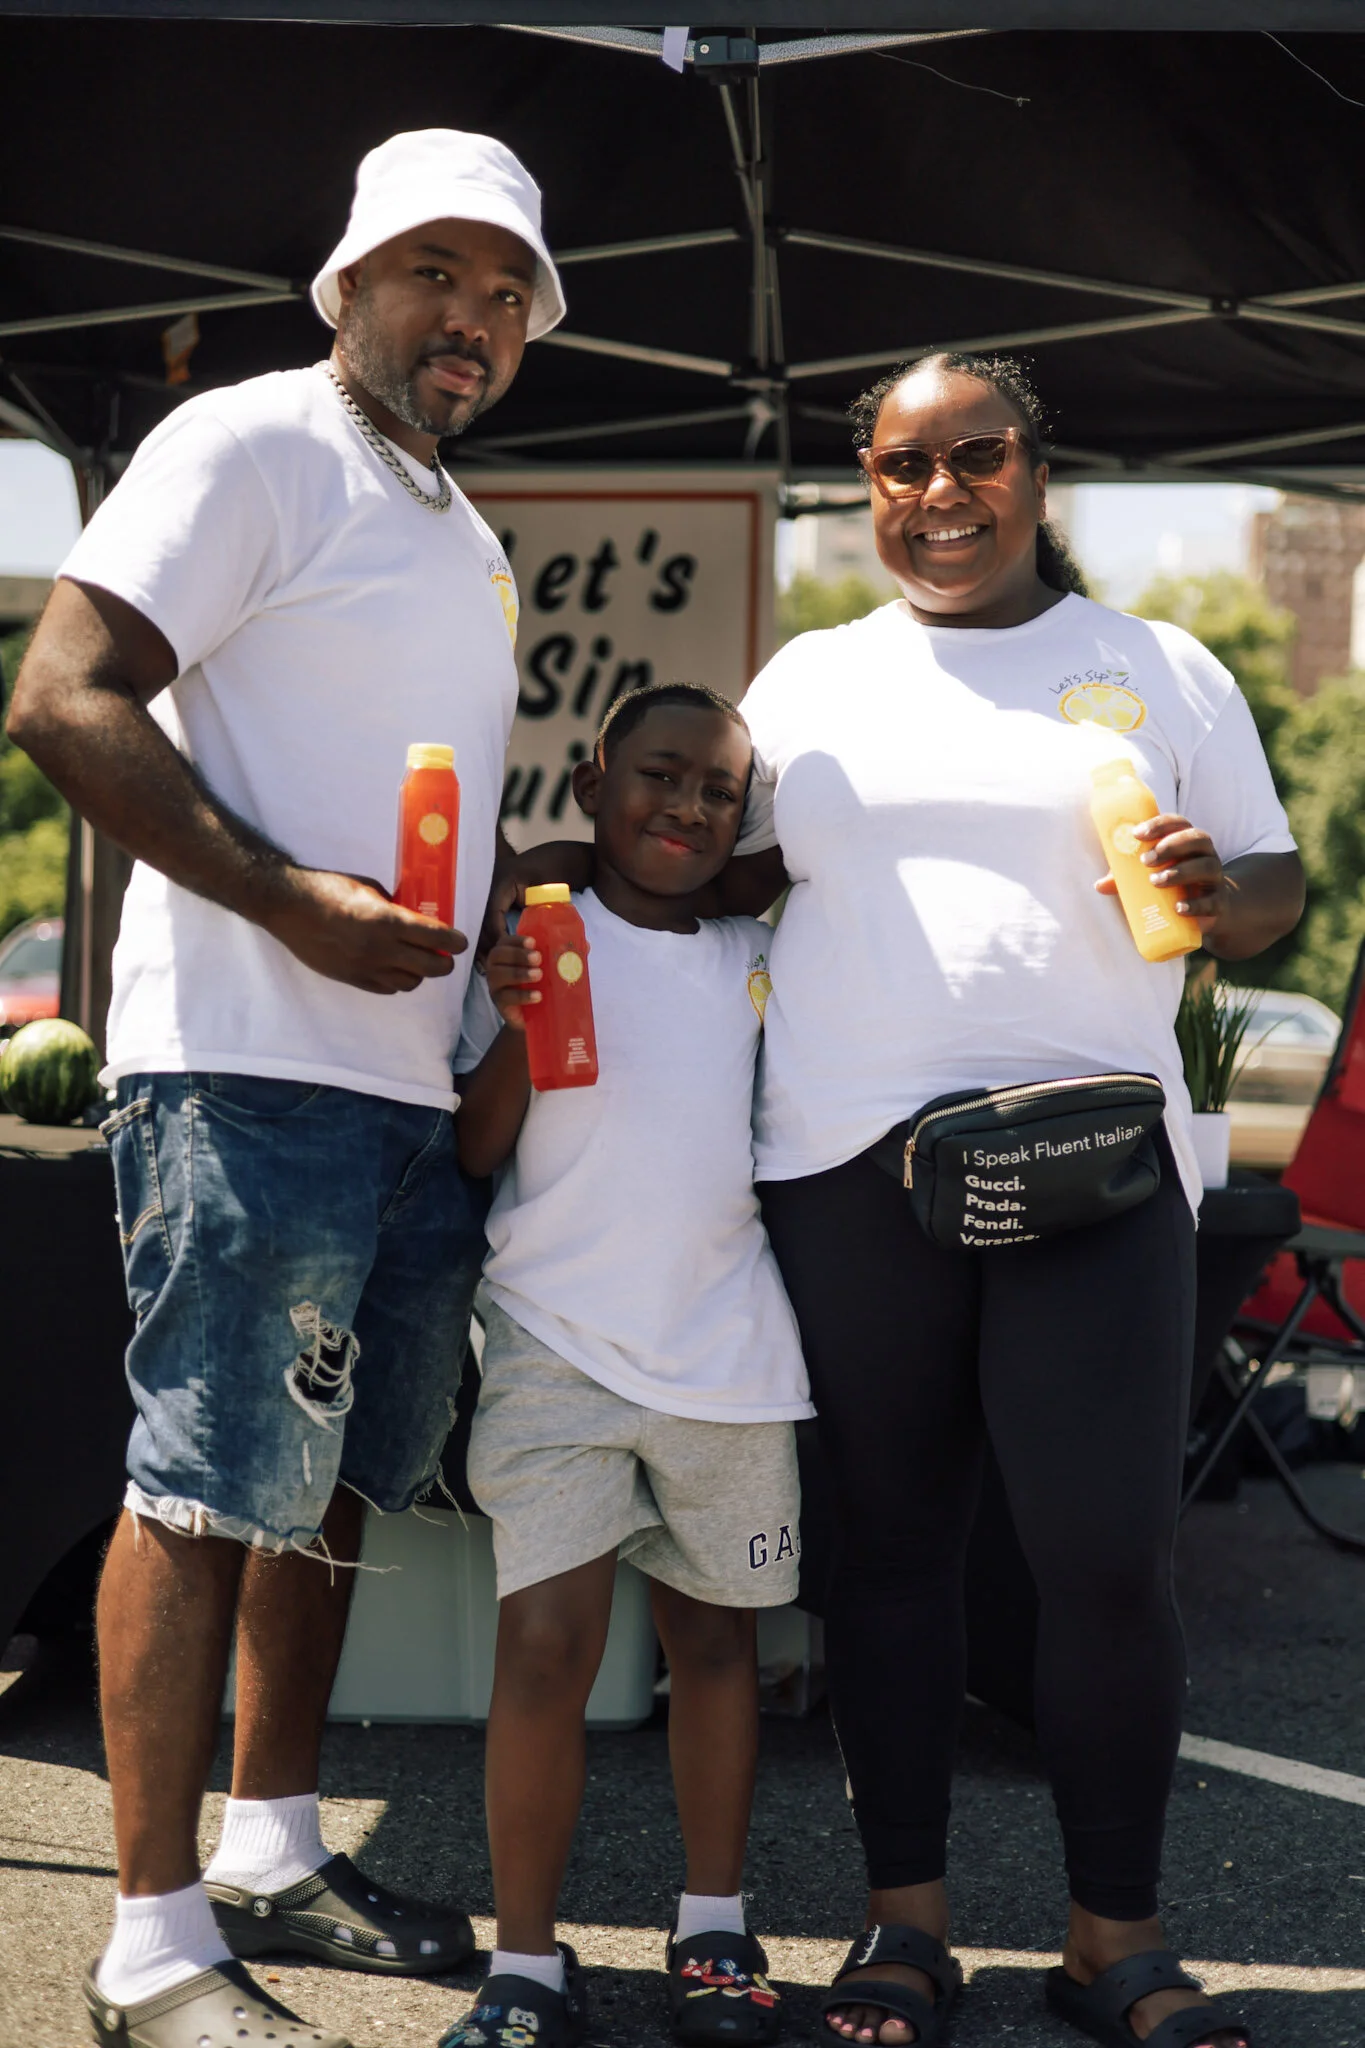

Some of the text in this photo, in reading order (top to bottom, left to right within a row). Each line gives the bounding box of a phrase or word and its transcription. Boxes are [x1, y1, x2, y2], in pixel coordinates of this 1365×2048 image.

[501, 528, 698, 615] et's
[1048, 673, 1082, 695] Let's
[963, 1124, 1145, 1169] I Speak Fluent Italian.
[964, 1174, 1026, 1192] Gucci.
[965, 1192, 1027, 1212] Prada.
[963, 1213, 1024, 1230] Fendi.
[959, 1232, 1040, 1247] Versace.
[748, 1524, 801, 1571] GA
